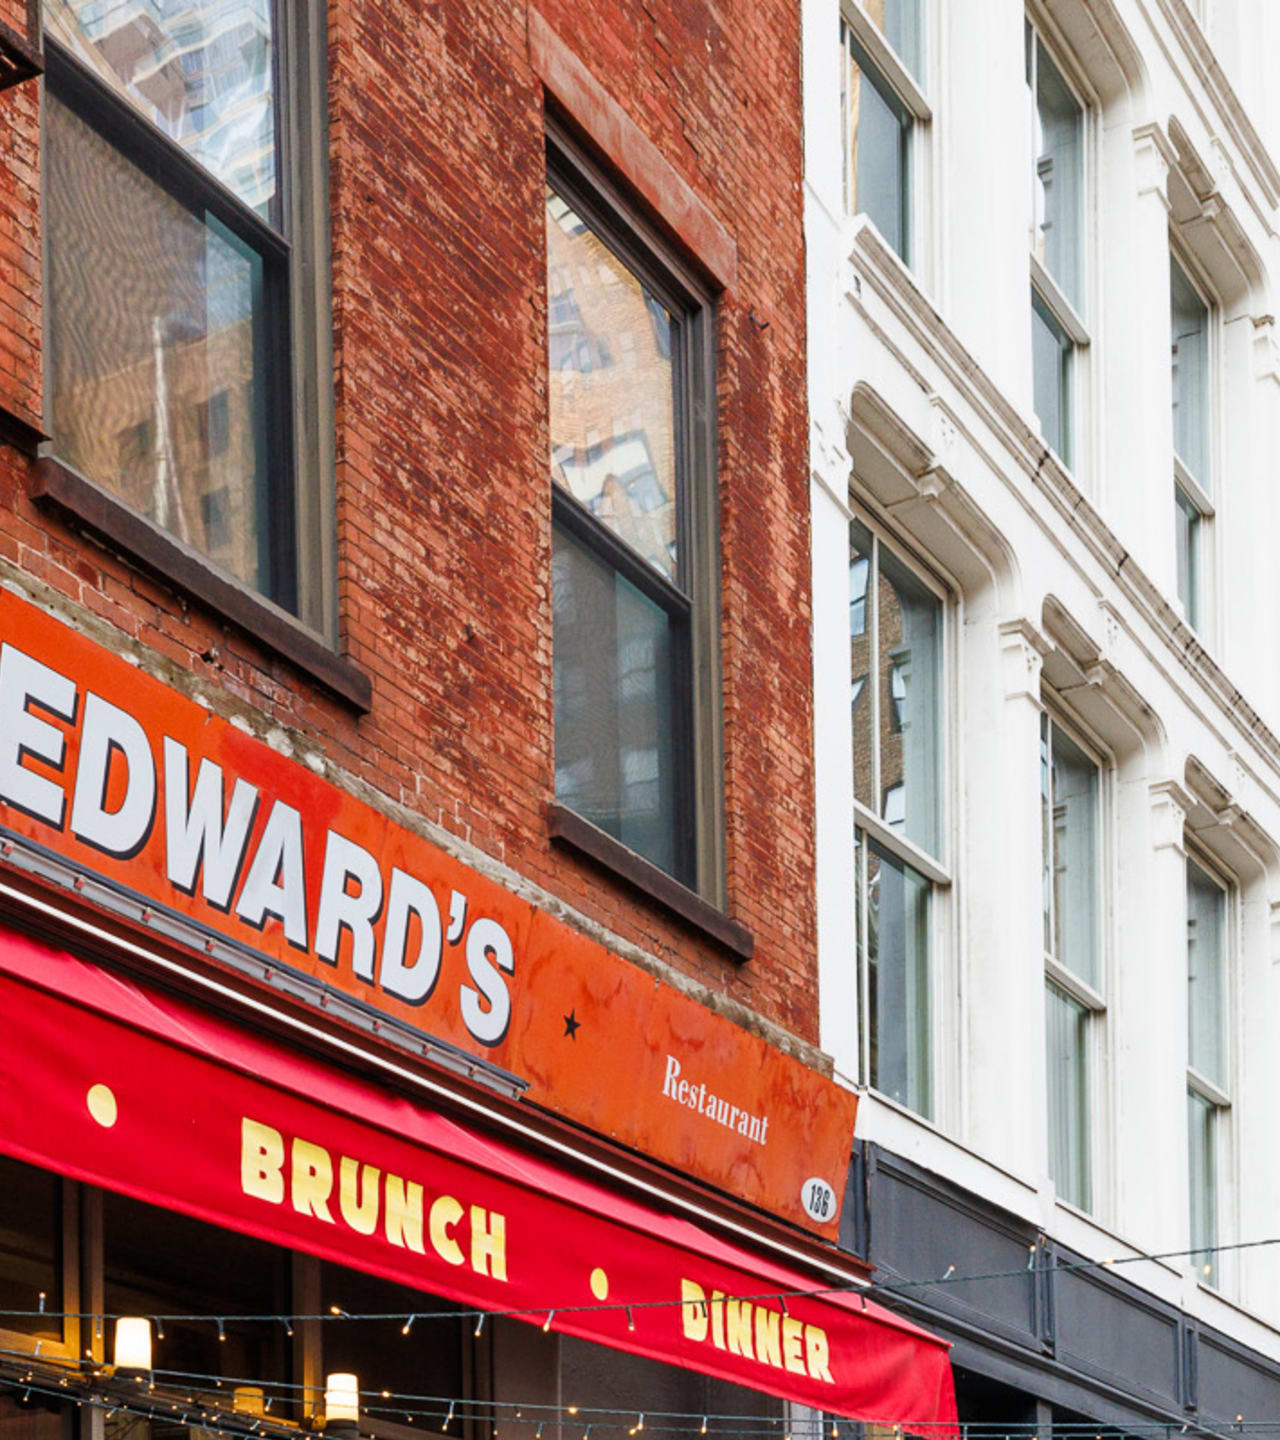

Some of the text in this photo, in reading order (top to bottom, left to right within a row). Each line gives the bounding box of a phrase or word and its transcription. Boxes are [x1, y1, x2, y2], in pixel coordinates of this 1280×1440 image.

[661, 1054, 769, 1146] Restaurant
[809, 1184, 830, 1217] 136
[240, 1117, 508, 1283] BRUNCH
[681, 1278, 835, 1385] DINNER
